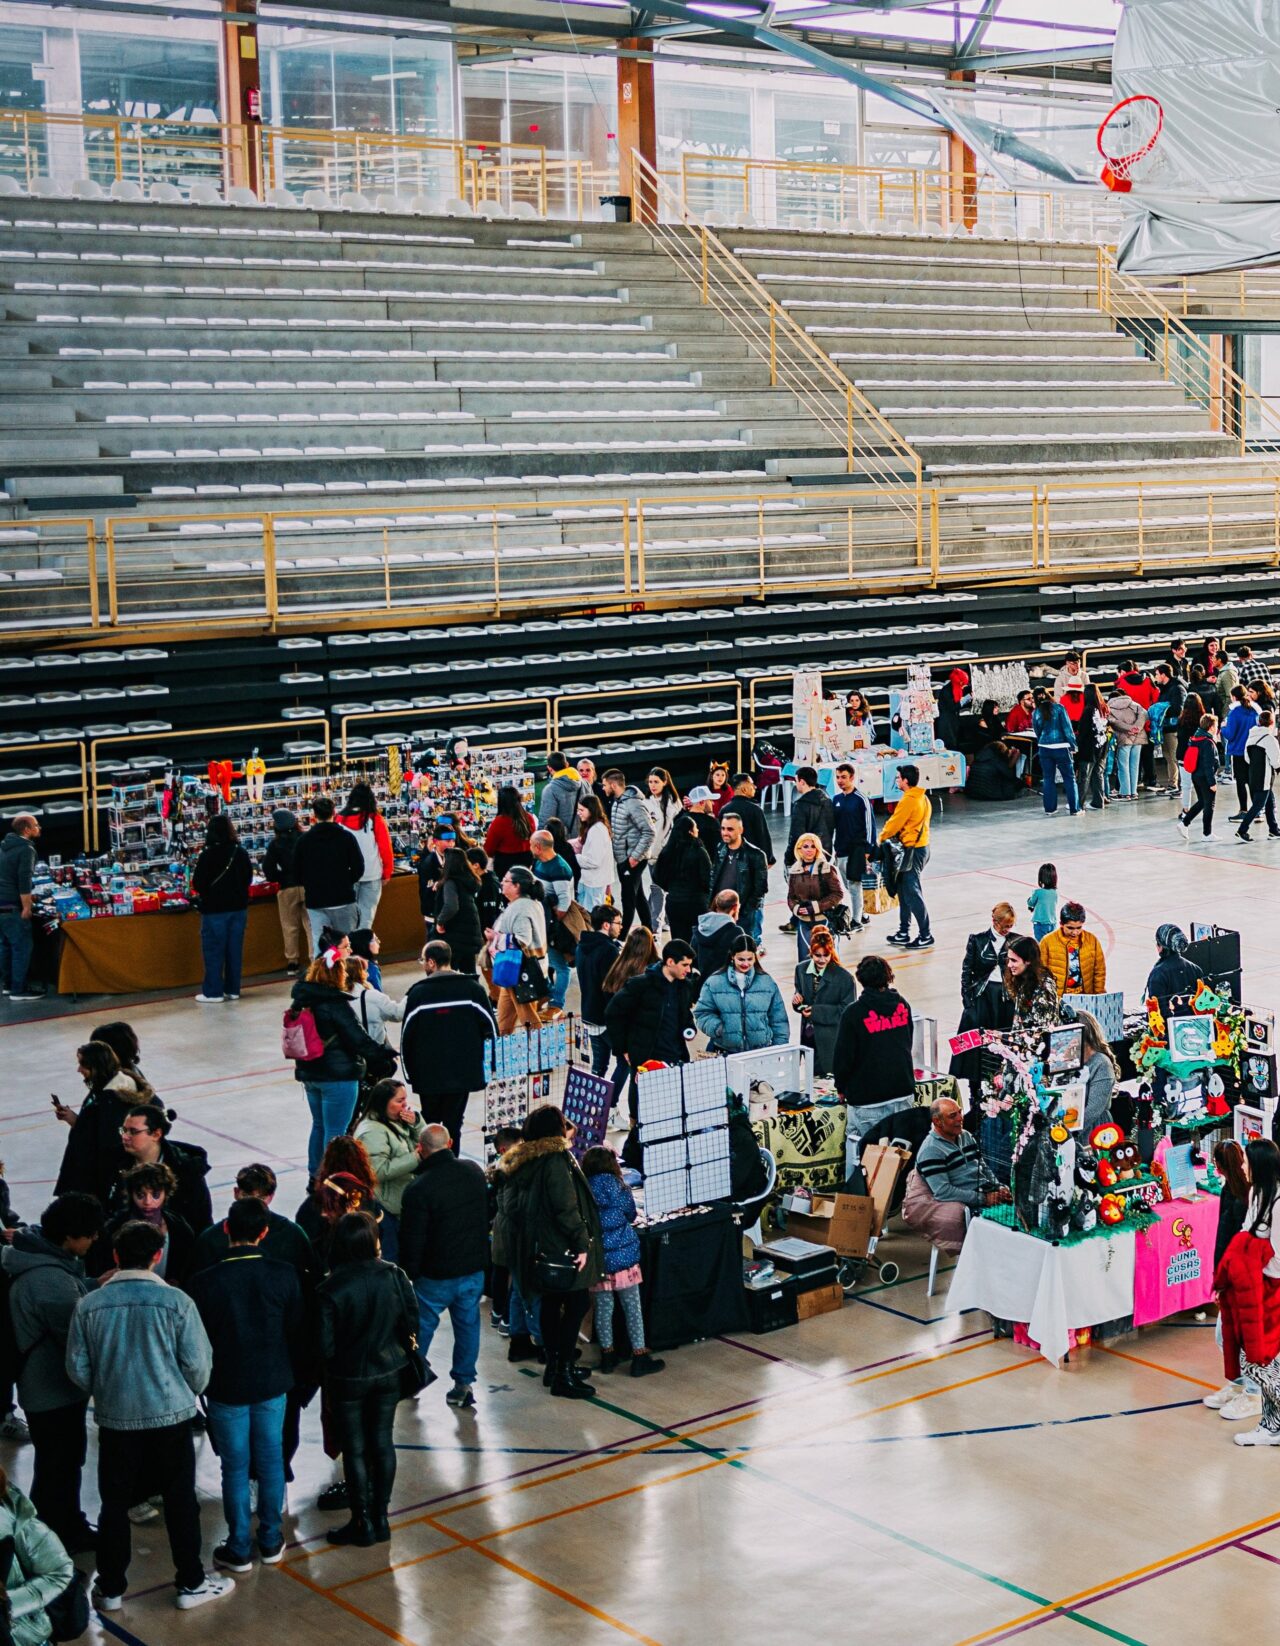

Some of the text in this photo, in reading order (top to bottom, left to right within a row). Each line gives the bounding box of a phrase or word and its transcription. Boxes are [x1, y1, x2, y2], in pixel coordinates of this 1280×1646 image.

[1171, 1249, 1197, 1264] LUNA
[1167, 1258, 1200, 1275] COSAS
[1167, 1268, 1200, 1285] FRIKIS
